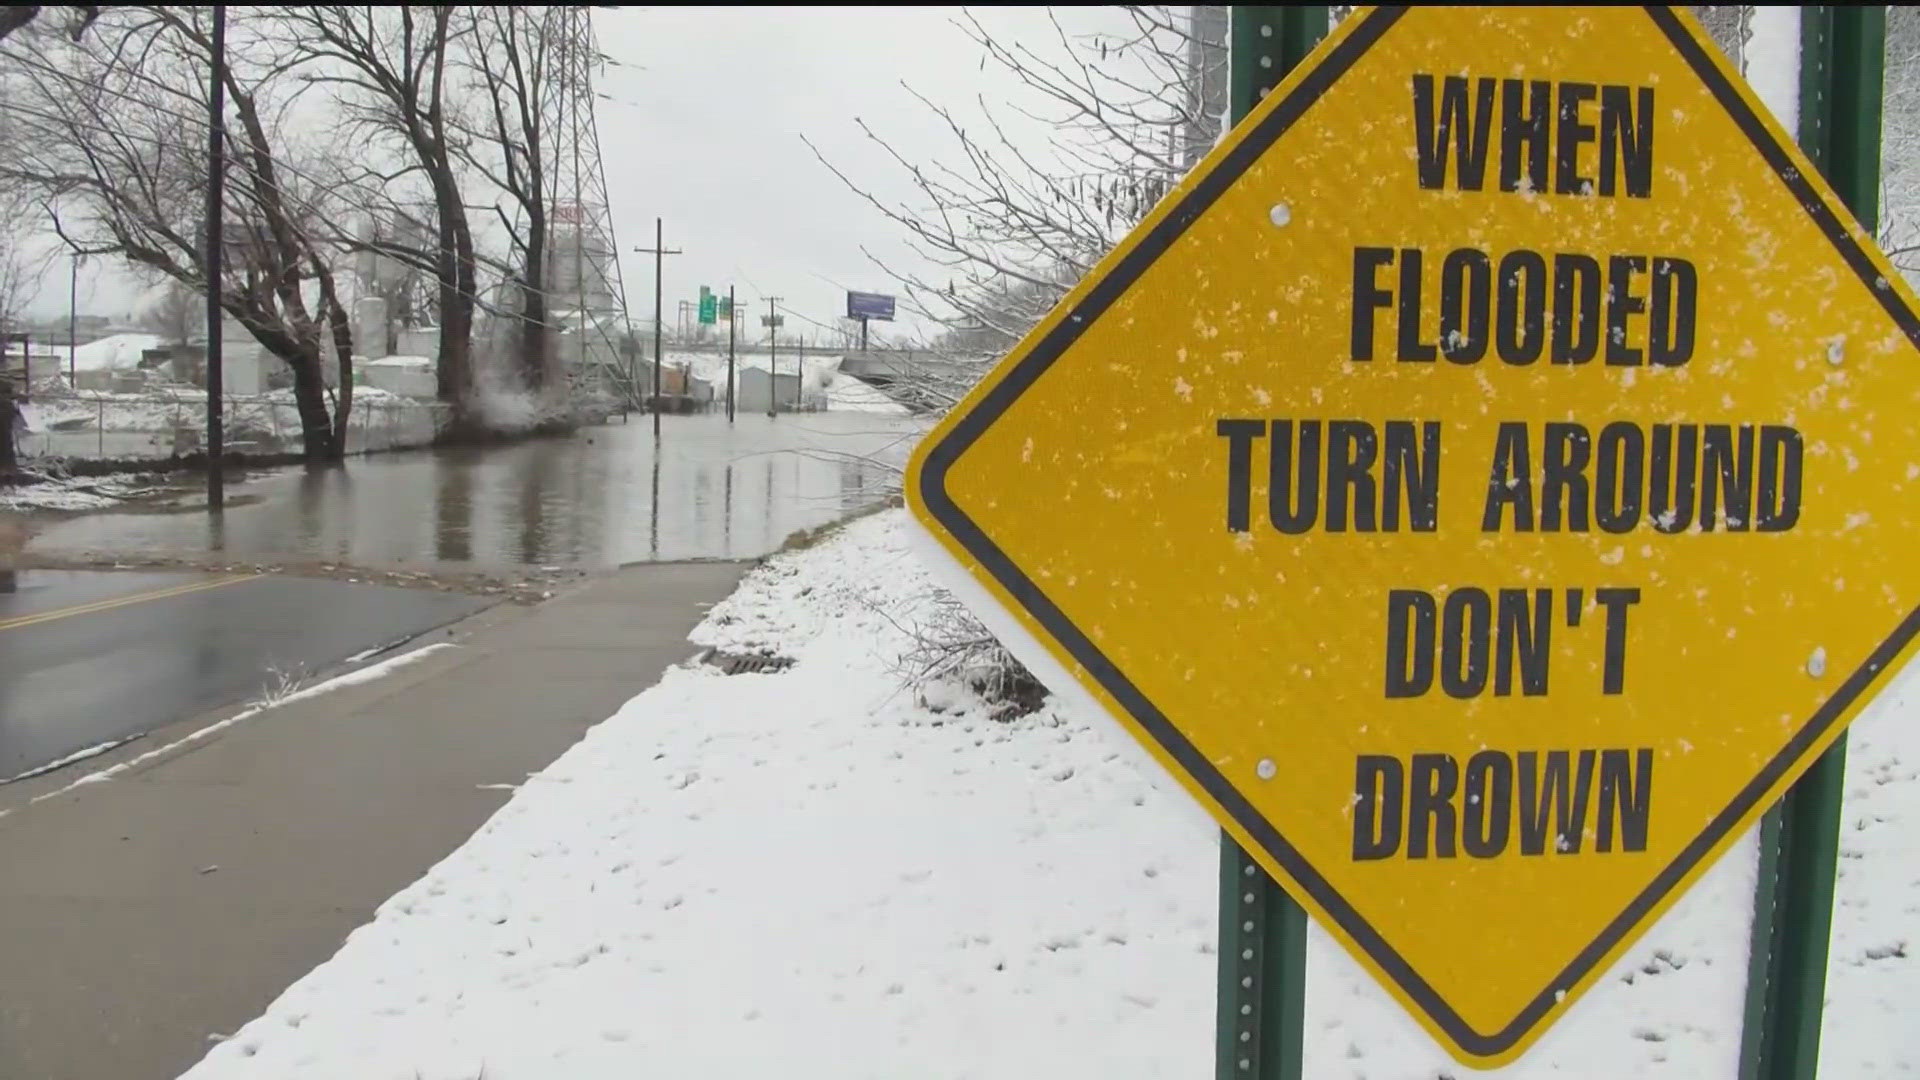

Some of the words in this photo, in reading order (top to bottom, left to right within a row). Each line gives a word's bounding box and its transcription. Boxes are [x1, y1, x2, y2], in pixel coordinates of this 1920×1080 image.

[1413, 75, 1653, 198] WHEN
[1352, 247, 1697, 366] FLOODED
[1217, 419, 1441, 534] TURN
[1483, 422, 1803, 533] AROUND
[1386, 587, 1640, 699] DON'T
[1353, 748, 1653, 861] DROWN
